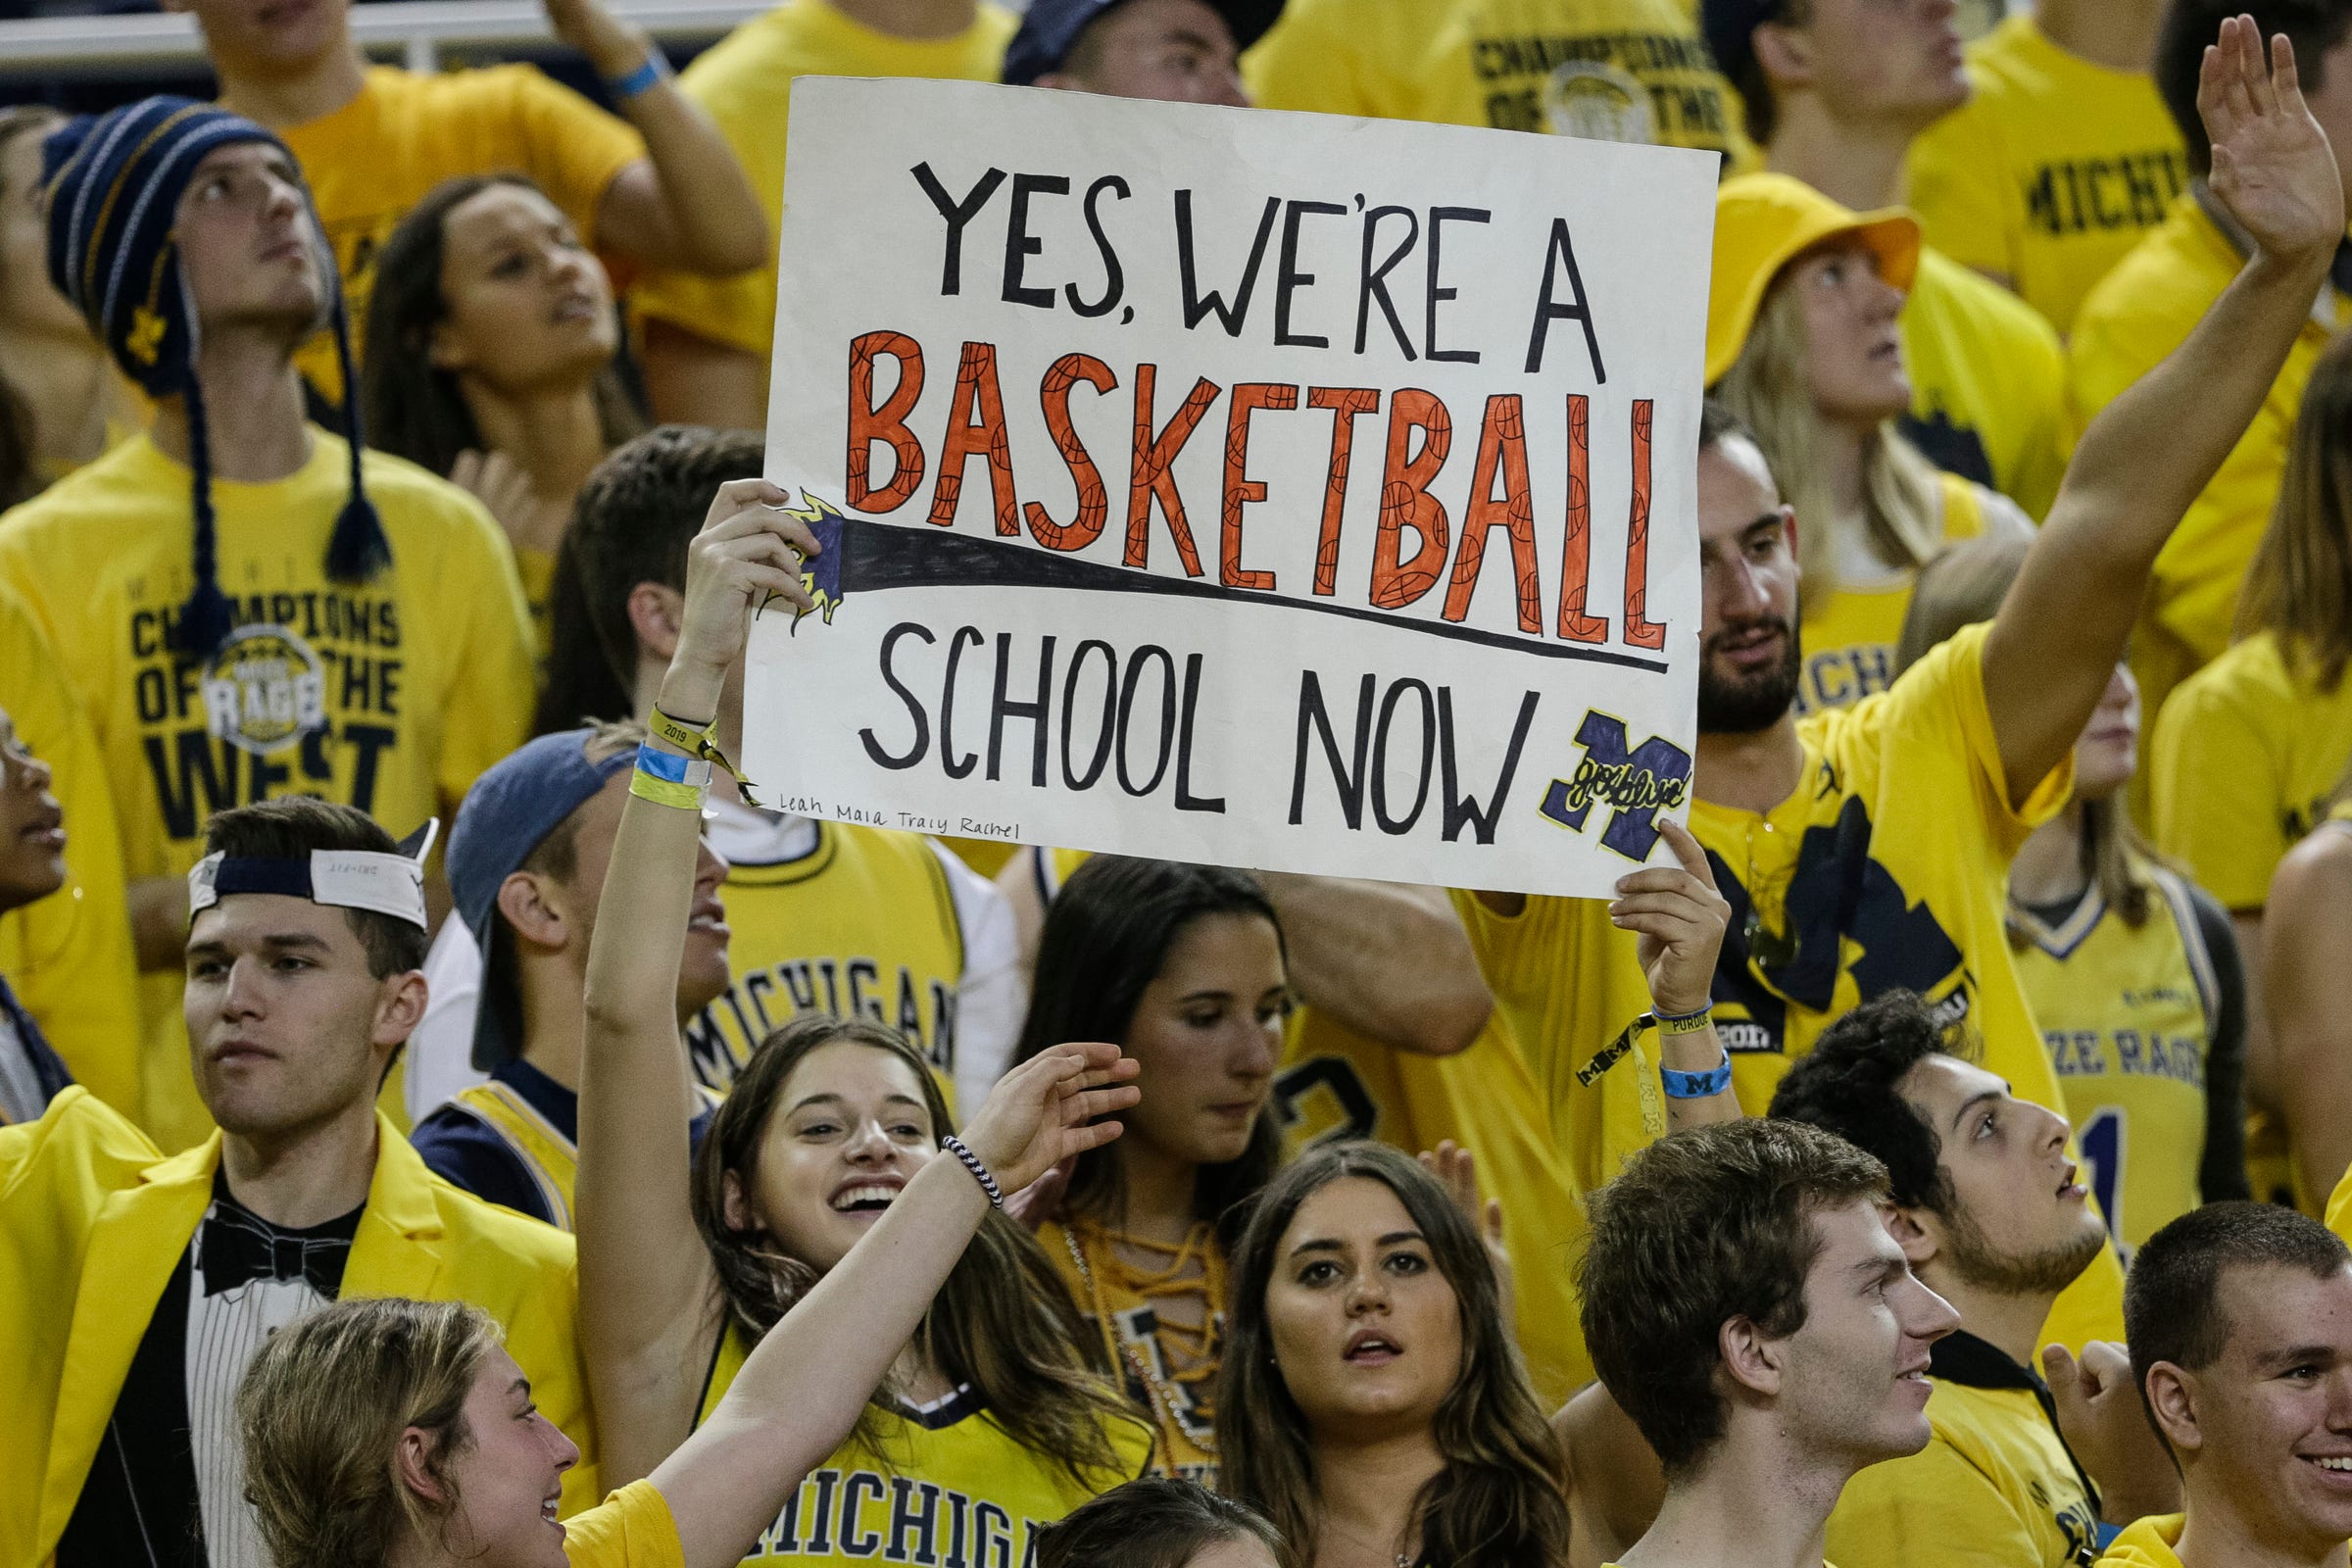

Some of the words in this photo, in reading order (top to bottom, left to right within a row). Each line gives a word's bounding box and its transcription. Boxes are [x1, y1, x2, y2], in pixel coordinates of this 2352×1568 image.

[908, 161, 1135, 325] YES,
[1174, 188, 1492, 365] WE'RE
[1524, 217, 1607, 385] A
[845, 329, 1669, 654] BASKETBALL
[131, 590, 402, 659] CHMPIONS
[663, 723, 688, 743] 2019
[858, 621, 1226, 814] SCHOOL
[1288, 669, 1542, 846] NOW
[778, 792, 823, 814] Leah
[1685, 1074, 1713, 1095] M
